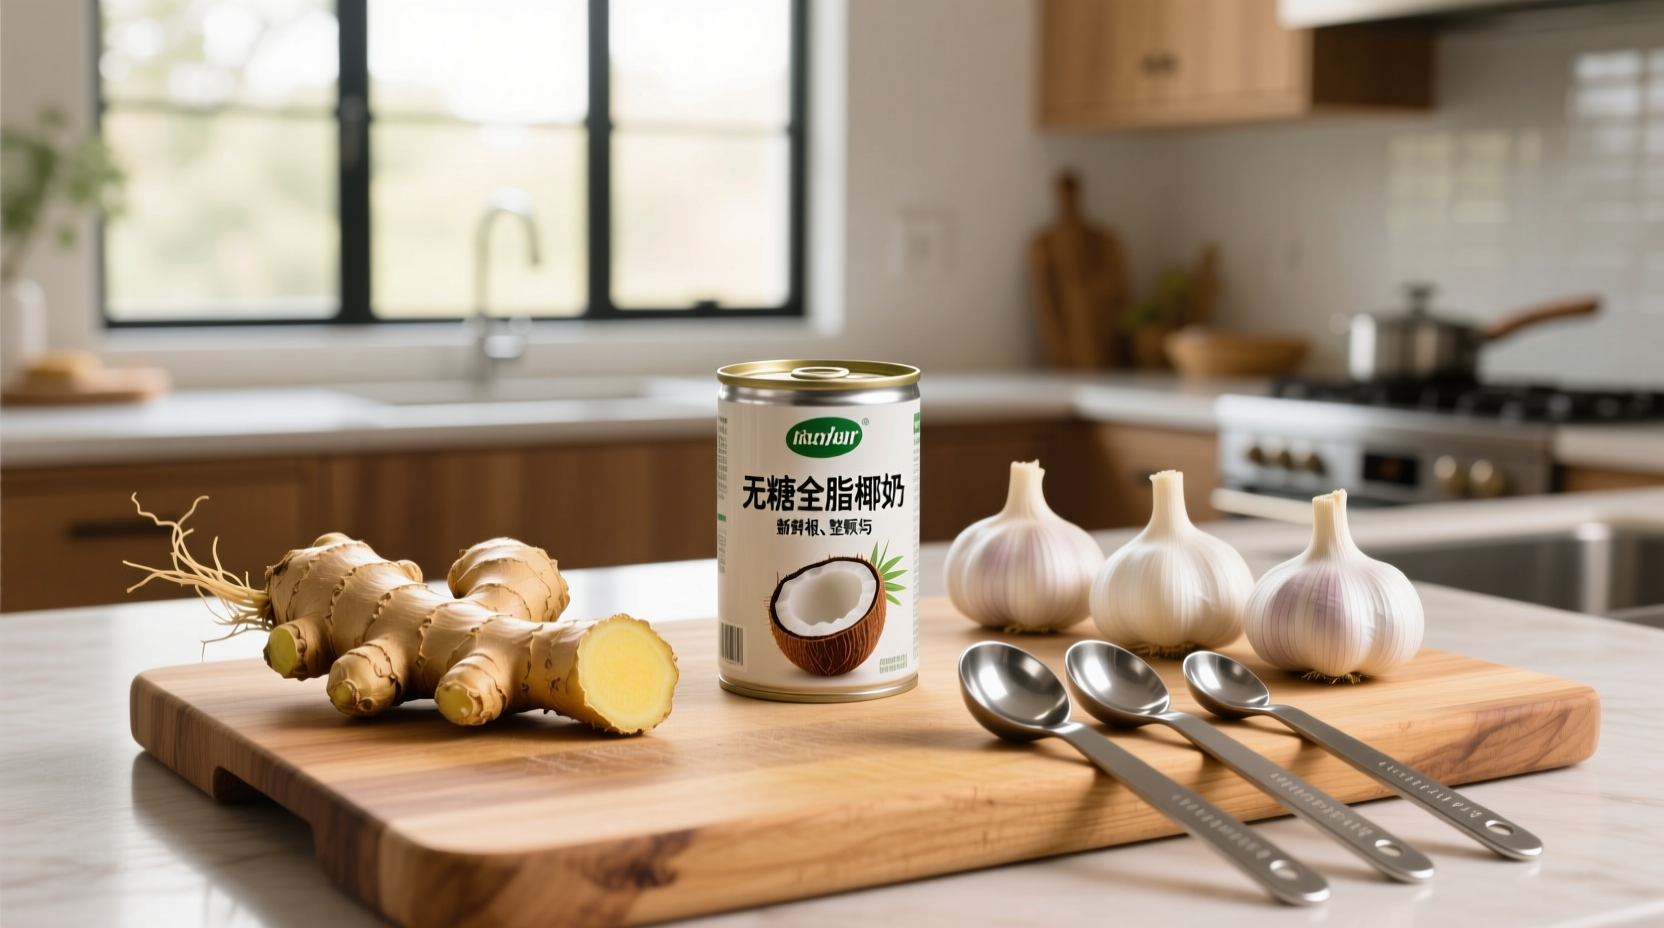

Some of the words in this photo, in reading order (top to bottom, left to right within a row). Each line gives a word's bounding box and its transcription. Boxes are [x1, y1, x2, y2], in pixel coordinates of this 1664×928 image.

[742, 473, 905, 511] 无糖全脂椰奶
